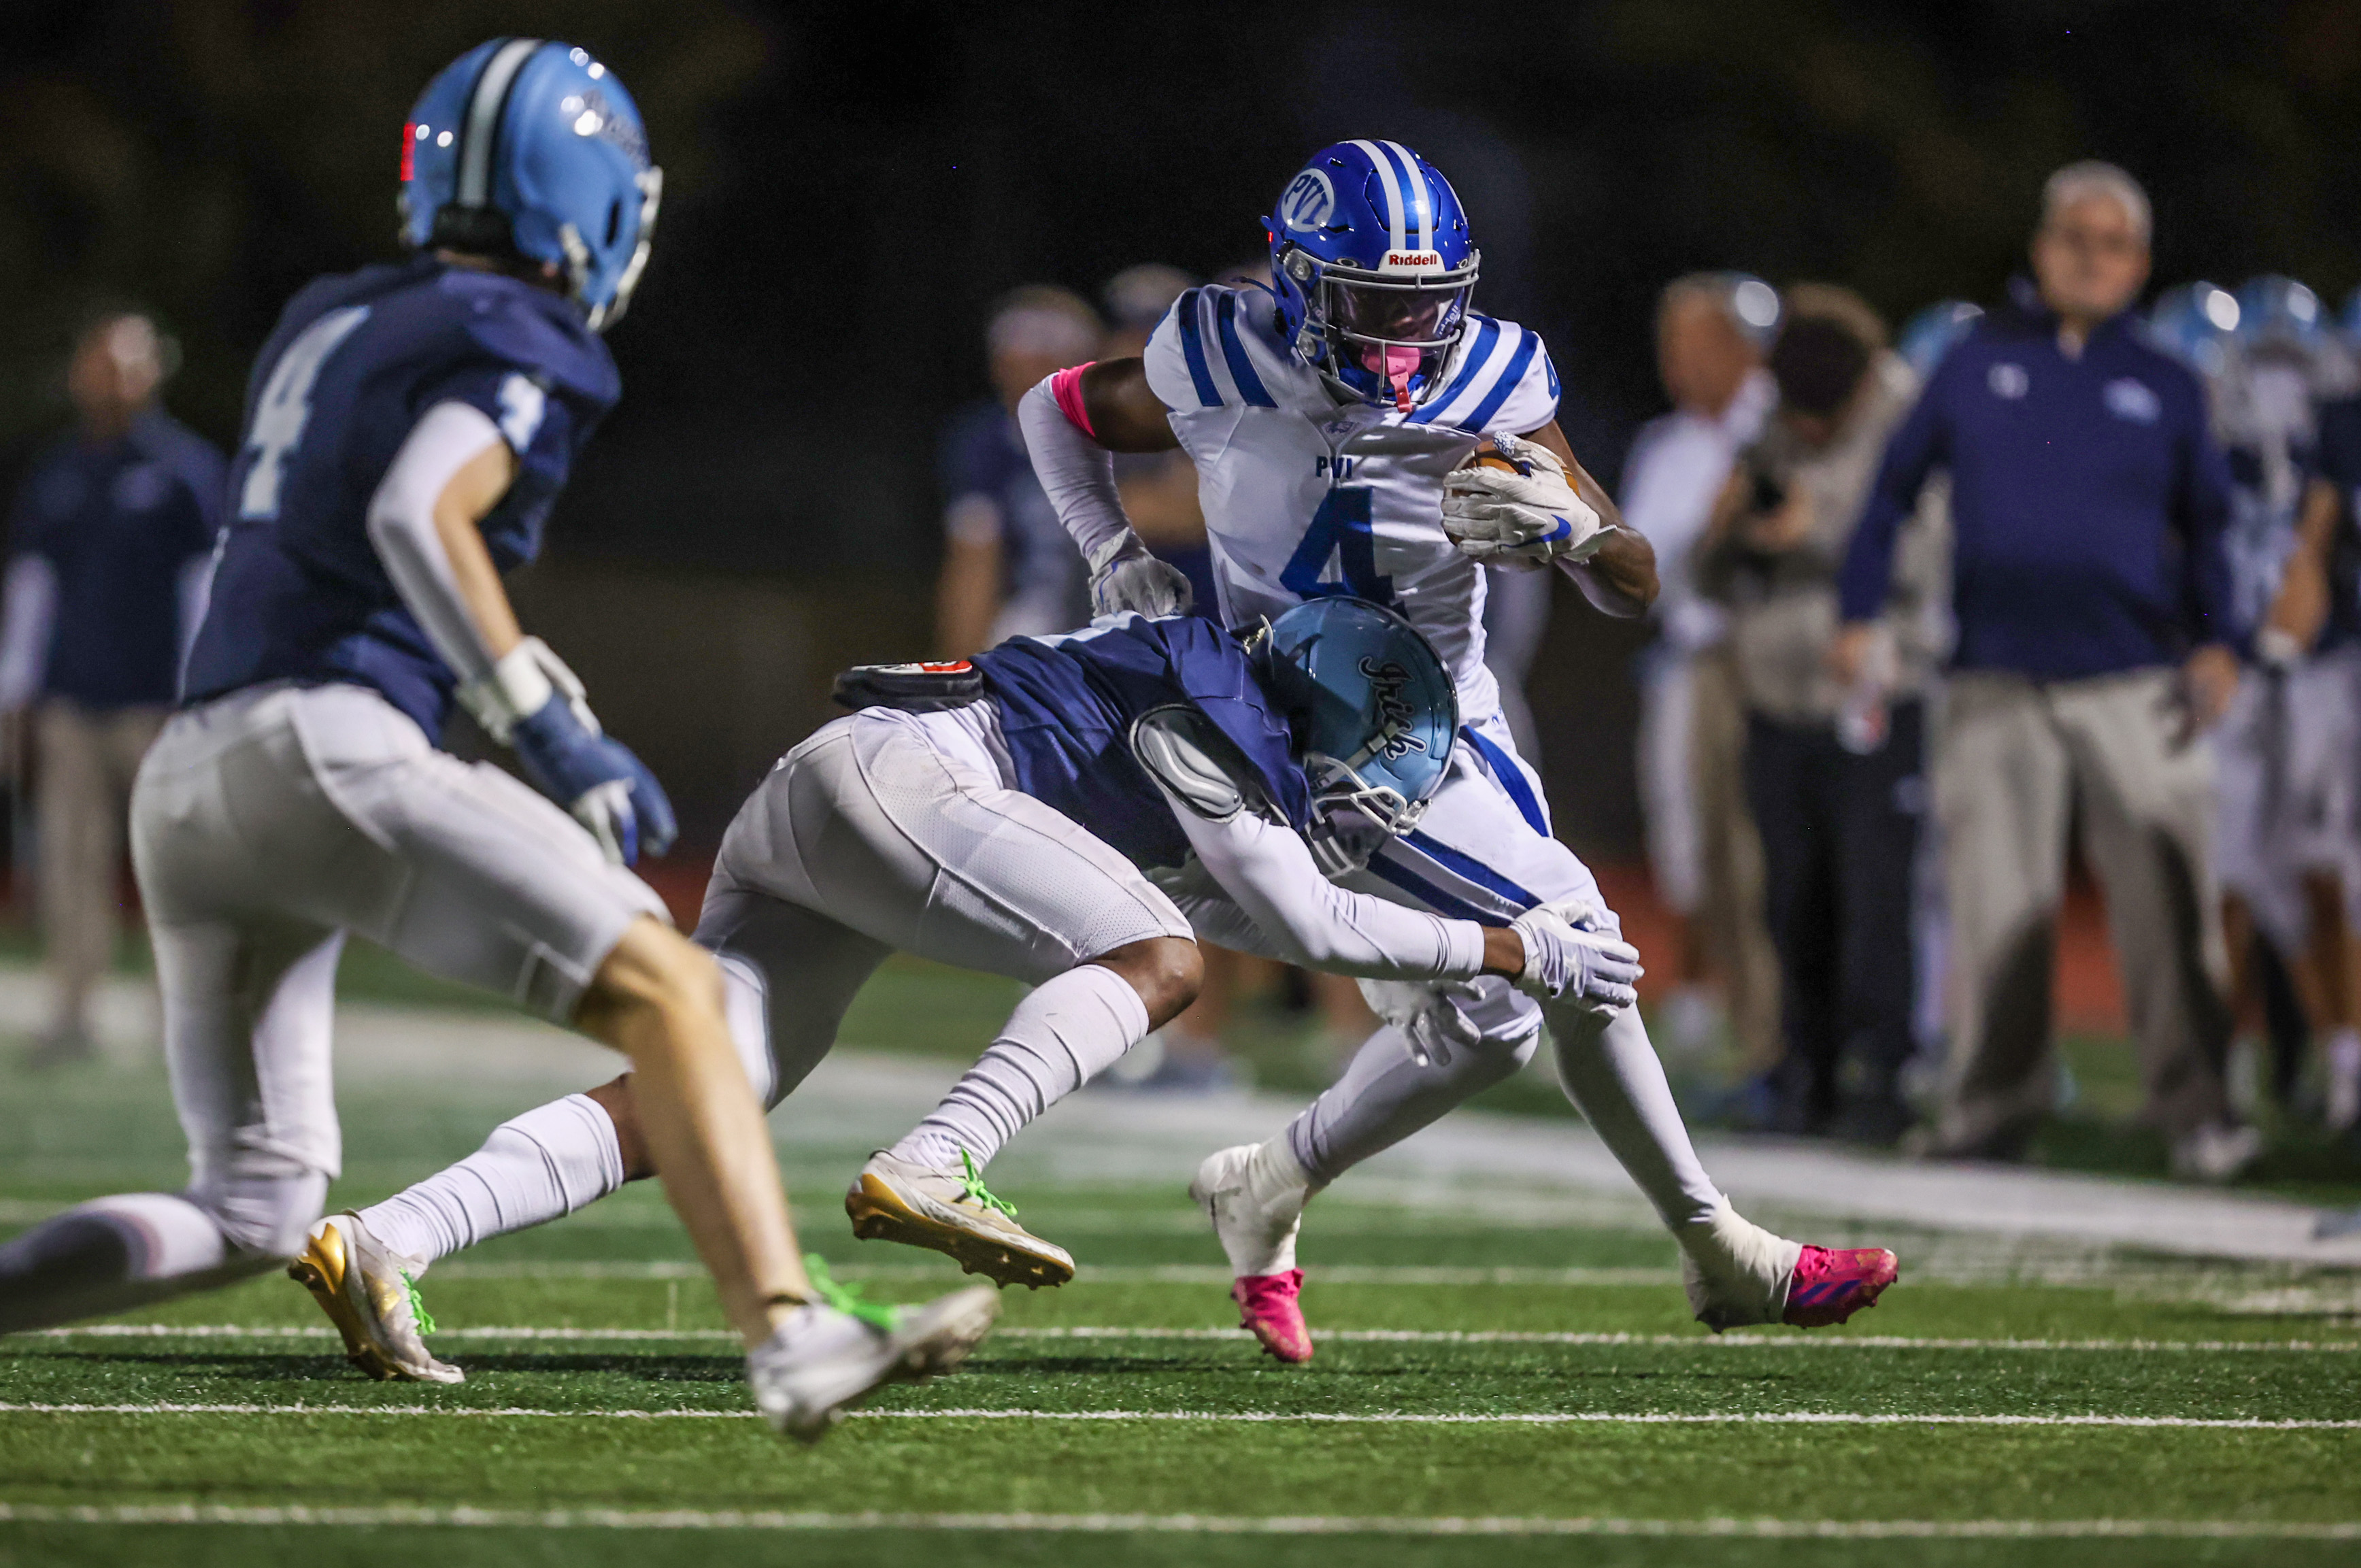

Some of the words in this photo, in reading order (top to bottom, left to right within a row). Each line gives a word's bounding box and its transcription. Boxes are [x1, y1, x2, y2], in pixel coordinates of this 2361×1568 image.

[1285, 174, 1328, 225] PVI
[1389, 254, 1437, 266] Riddell
[241, 305, 371, 521] 4
[1316, 455, 1353, 480] PVI
[1279, 486, 1411, 622] 4
